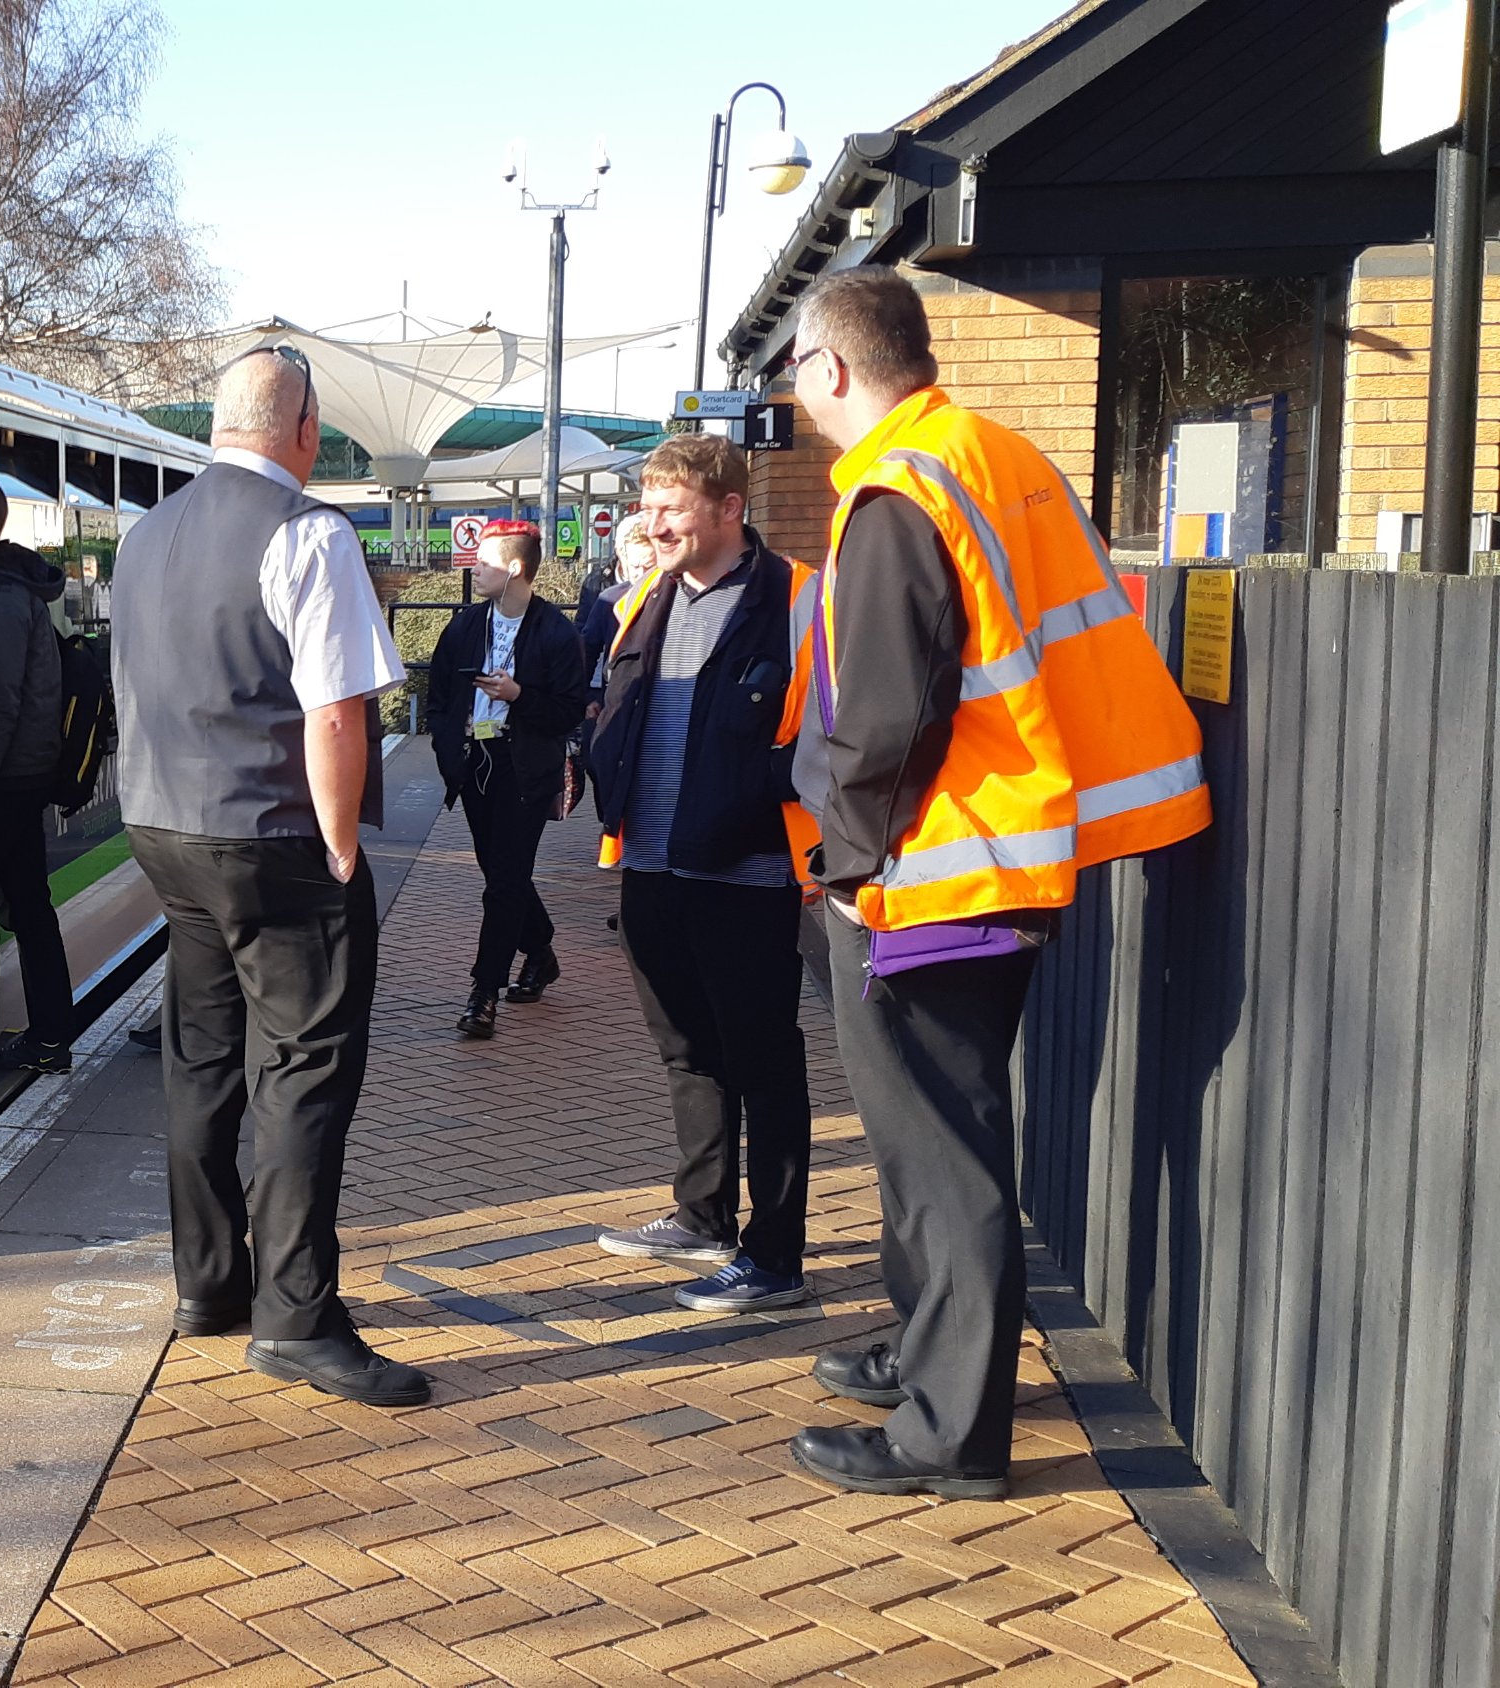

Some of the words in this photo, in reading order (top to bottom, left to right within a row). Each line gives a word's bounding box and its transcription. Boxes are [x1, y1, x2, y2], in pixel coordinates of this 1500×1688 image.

[702, 394, 742, 404] Smartcard
[701, 405, 726, 413] reader
[757, 407, 774, 441] 1
[754, 441, 768, 449] Rail
[768, 441, 781, 449] Car
[561, 526, 571, 541] 9
[14, 1279, 165, 1371] GAP
